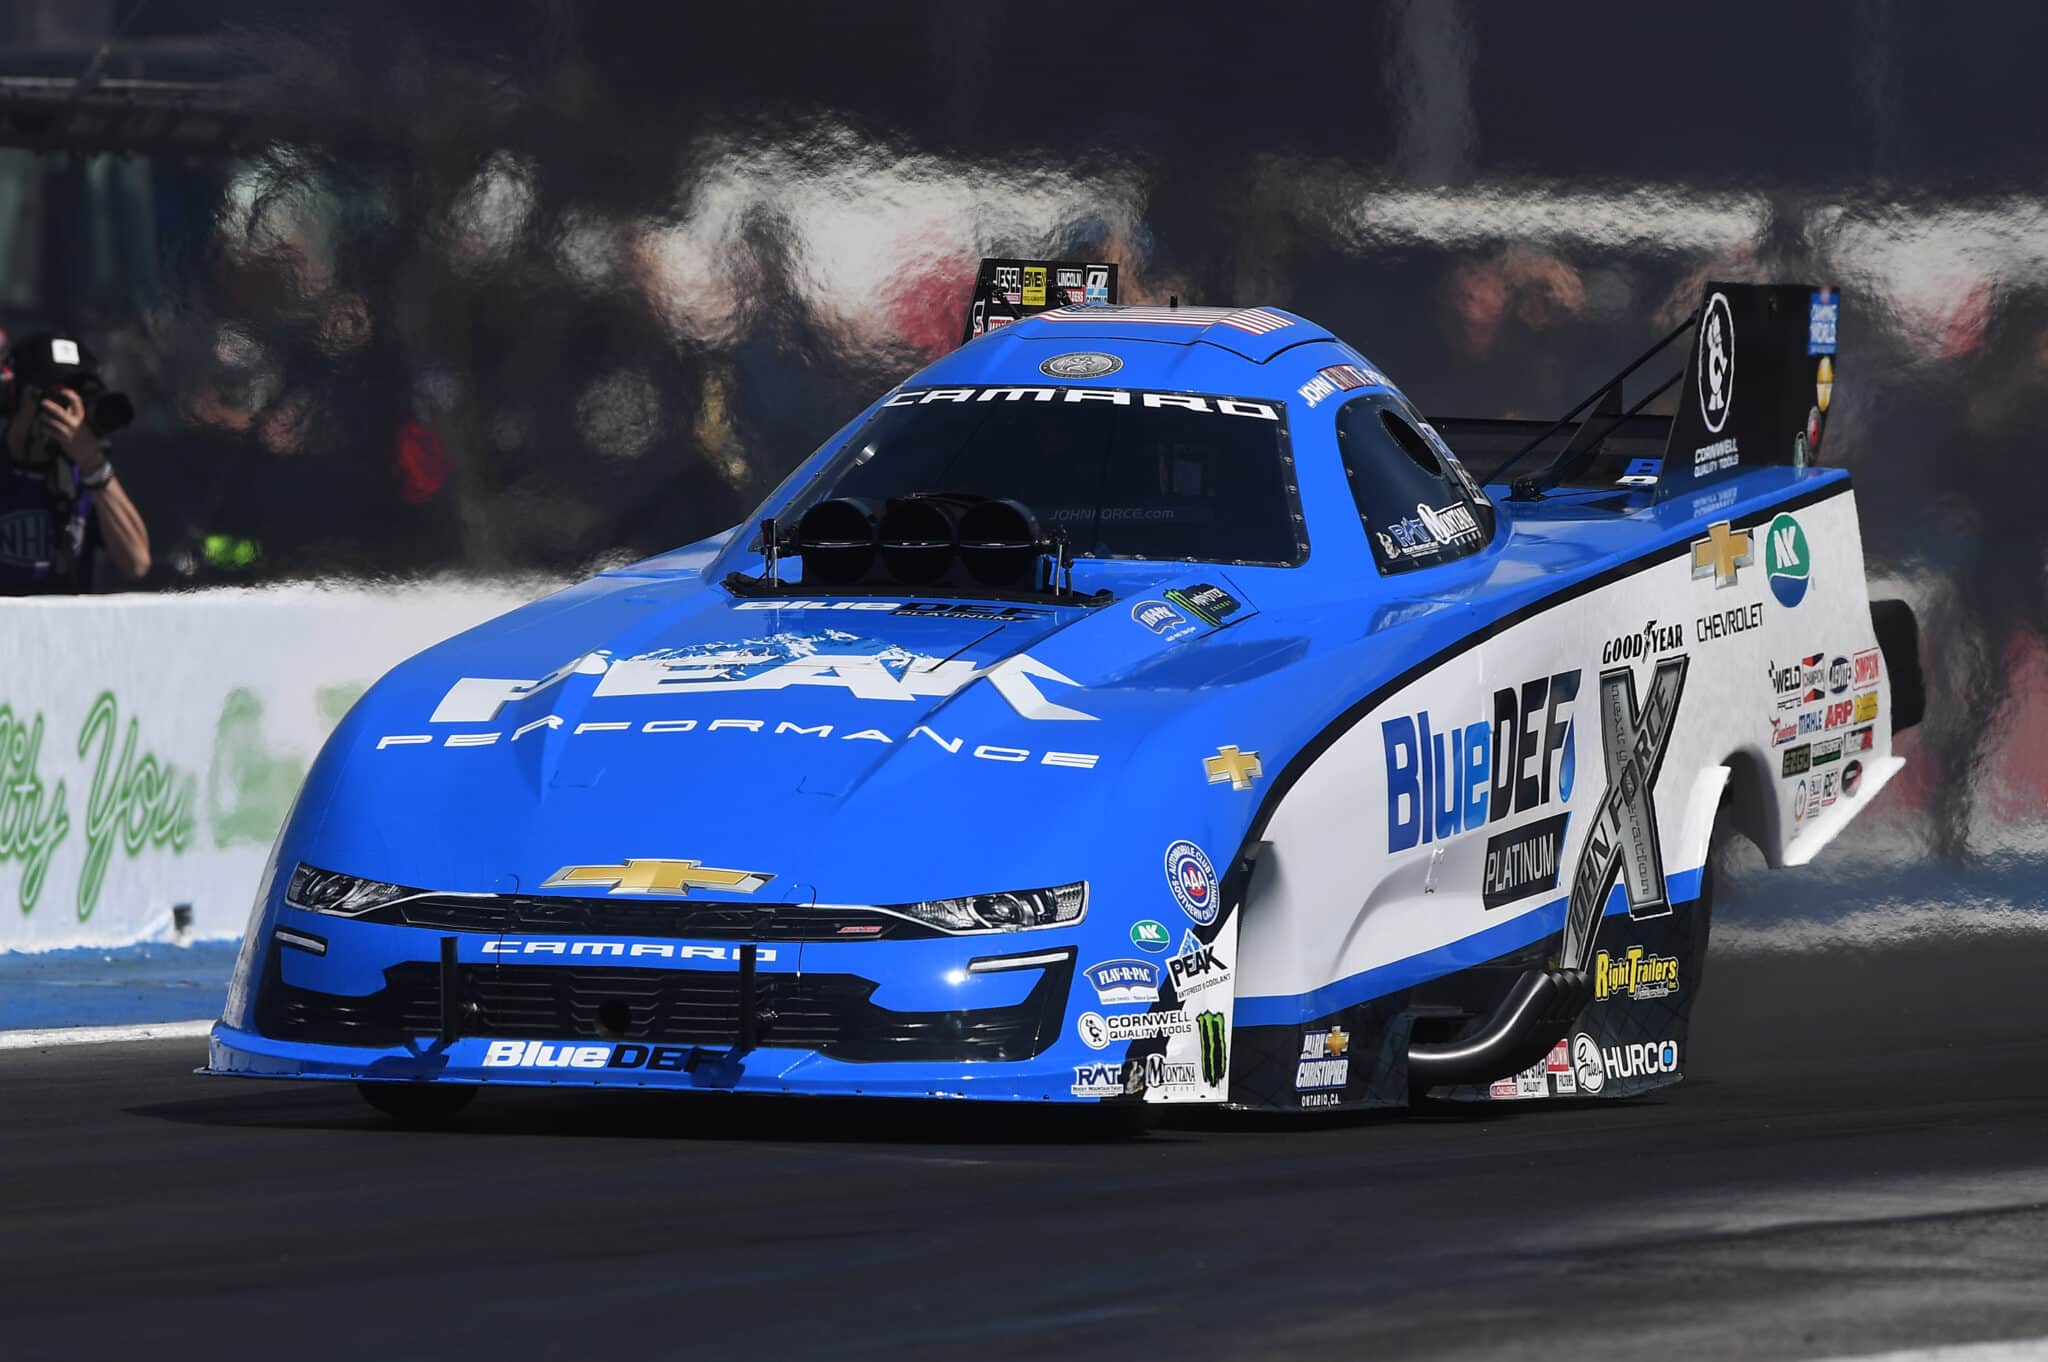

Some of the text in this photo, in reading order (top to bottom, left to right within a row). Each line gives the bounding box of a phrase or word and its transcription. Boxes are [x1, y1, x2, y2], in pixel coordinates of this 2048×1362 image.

[1058, 271, 1082, 287] LINCOLN
[882, 388, 1280, 420] CAMARO
[1297, 374, 1337, 408] JOHN
[1695, 438, 1738, 463] CORNWELL
[1696, 603, 1763, 642] CHEVROLET
[430, 651, 1101, 723] PEAK
[1776, 666, 1801, 694] WELD
[1824, 700, 1854, 730] ARP
[376, 714, 1101, 768] PERFORMANCE
[78, 690, 193, 924] You
[1195, 851, 1212, 874] CLUB
[1484, 833, 1555, 896] PLATINUM
[1183, 869, 1206, 890] AAA
[1172, 880, 1203, 920] SOUTHERN
[481, 940, 776, 963] CAMARO
[1169, 946, 1228, 987] PEAK
[1206, 973, 1231, 988] COOLANT
[1108, 1012, 1190, 1029] CORNWELL
[1109, 1024, 1192, 1039] QUALITY TOOLS
[1296, 1060, 1349, 1088] CHRISTOPHER
[1602, 1040, 1678, 1080] HURCO
